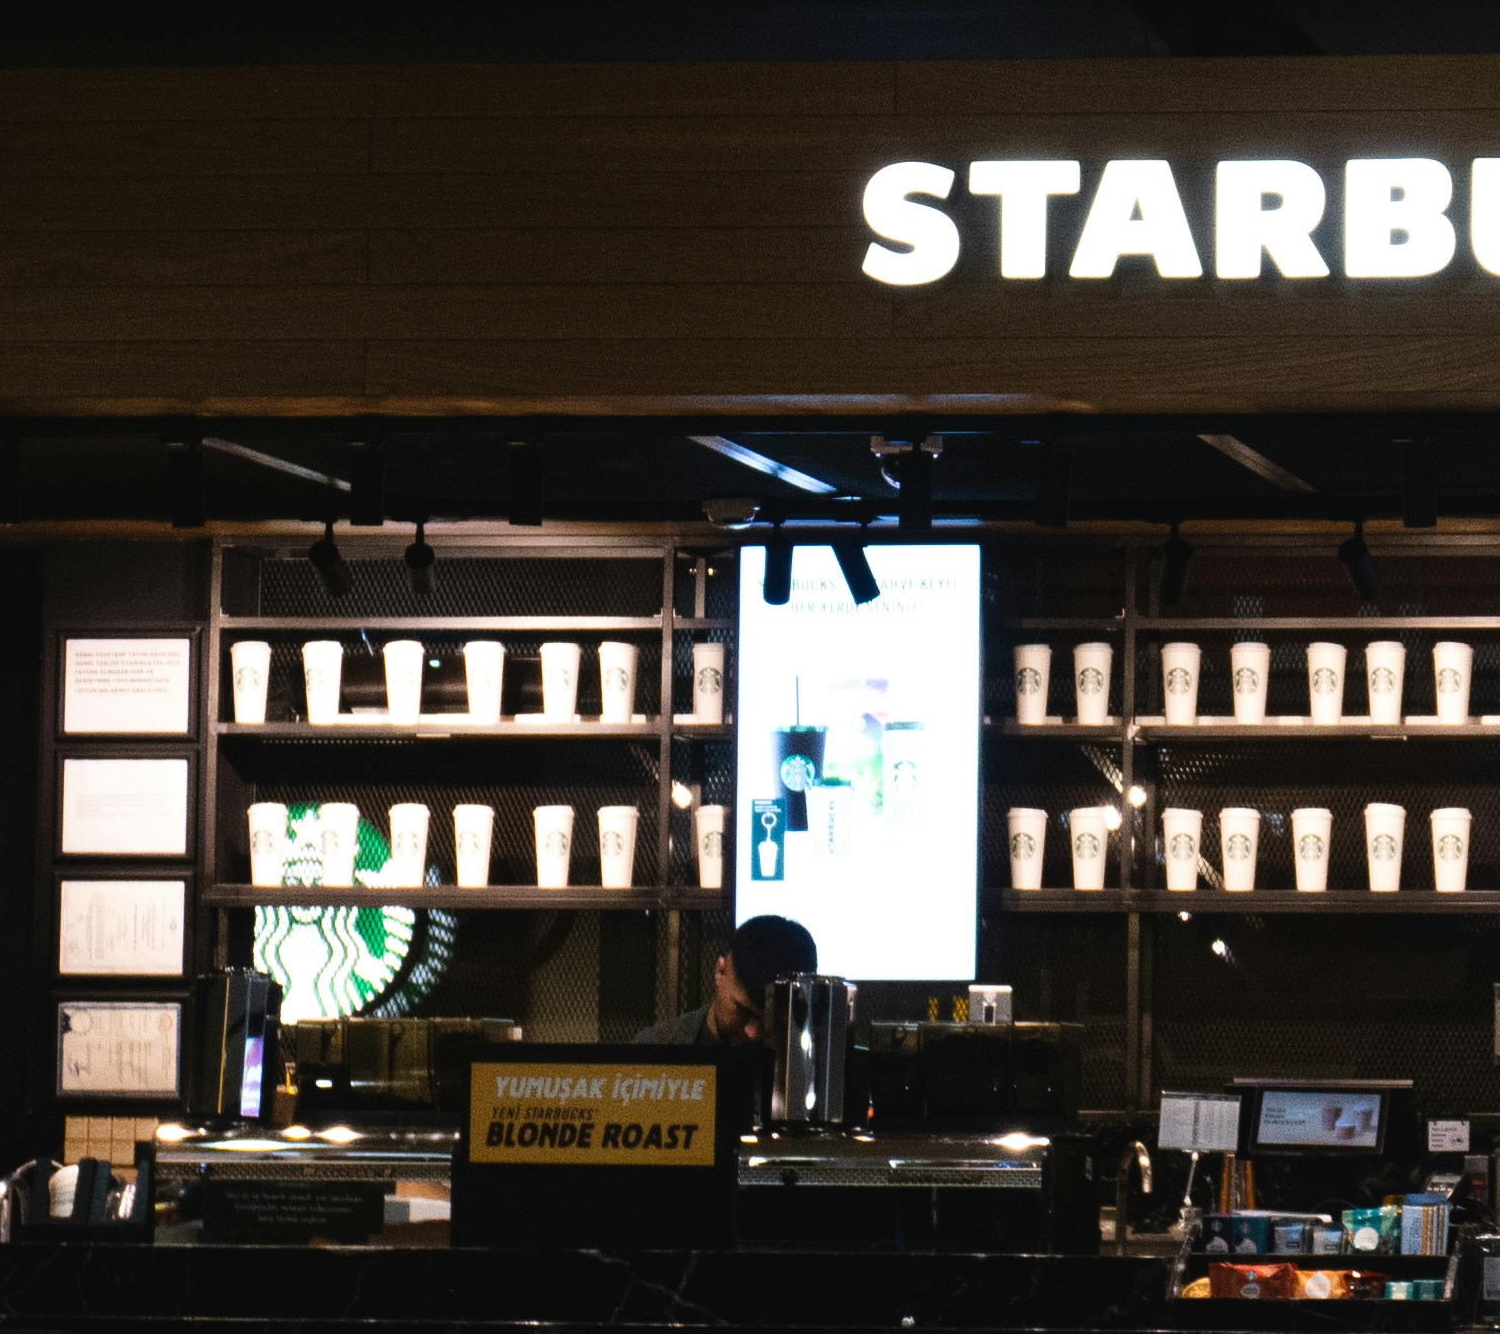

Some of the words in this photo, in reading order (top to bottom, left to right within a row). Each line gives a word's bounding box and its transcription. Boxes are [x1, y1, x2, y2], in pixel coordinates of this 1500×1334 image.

[495, 1074, 607, 1106] YUMUŞAK
[611, 1072, 707, 1107] İÇİMİYLE
[491, 1103, 521, 1120] YENİ
[485, 1122, 596, 1149] BLONDE
[601, 1124, 700, 1150] ROAST
